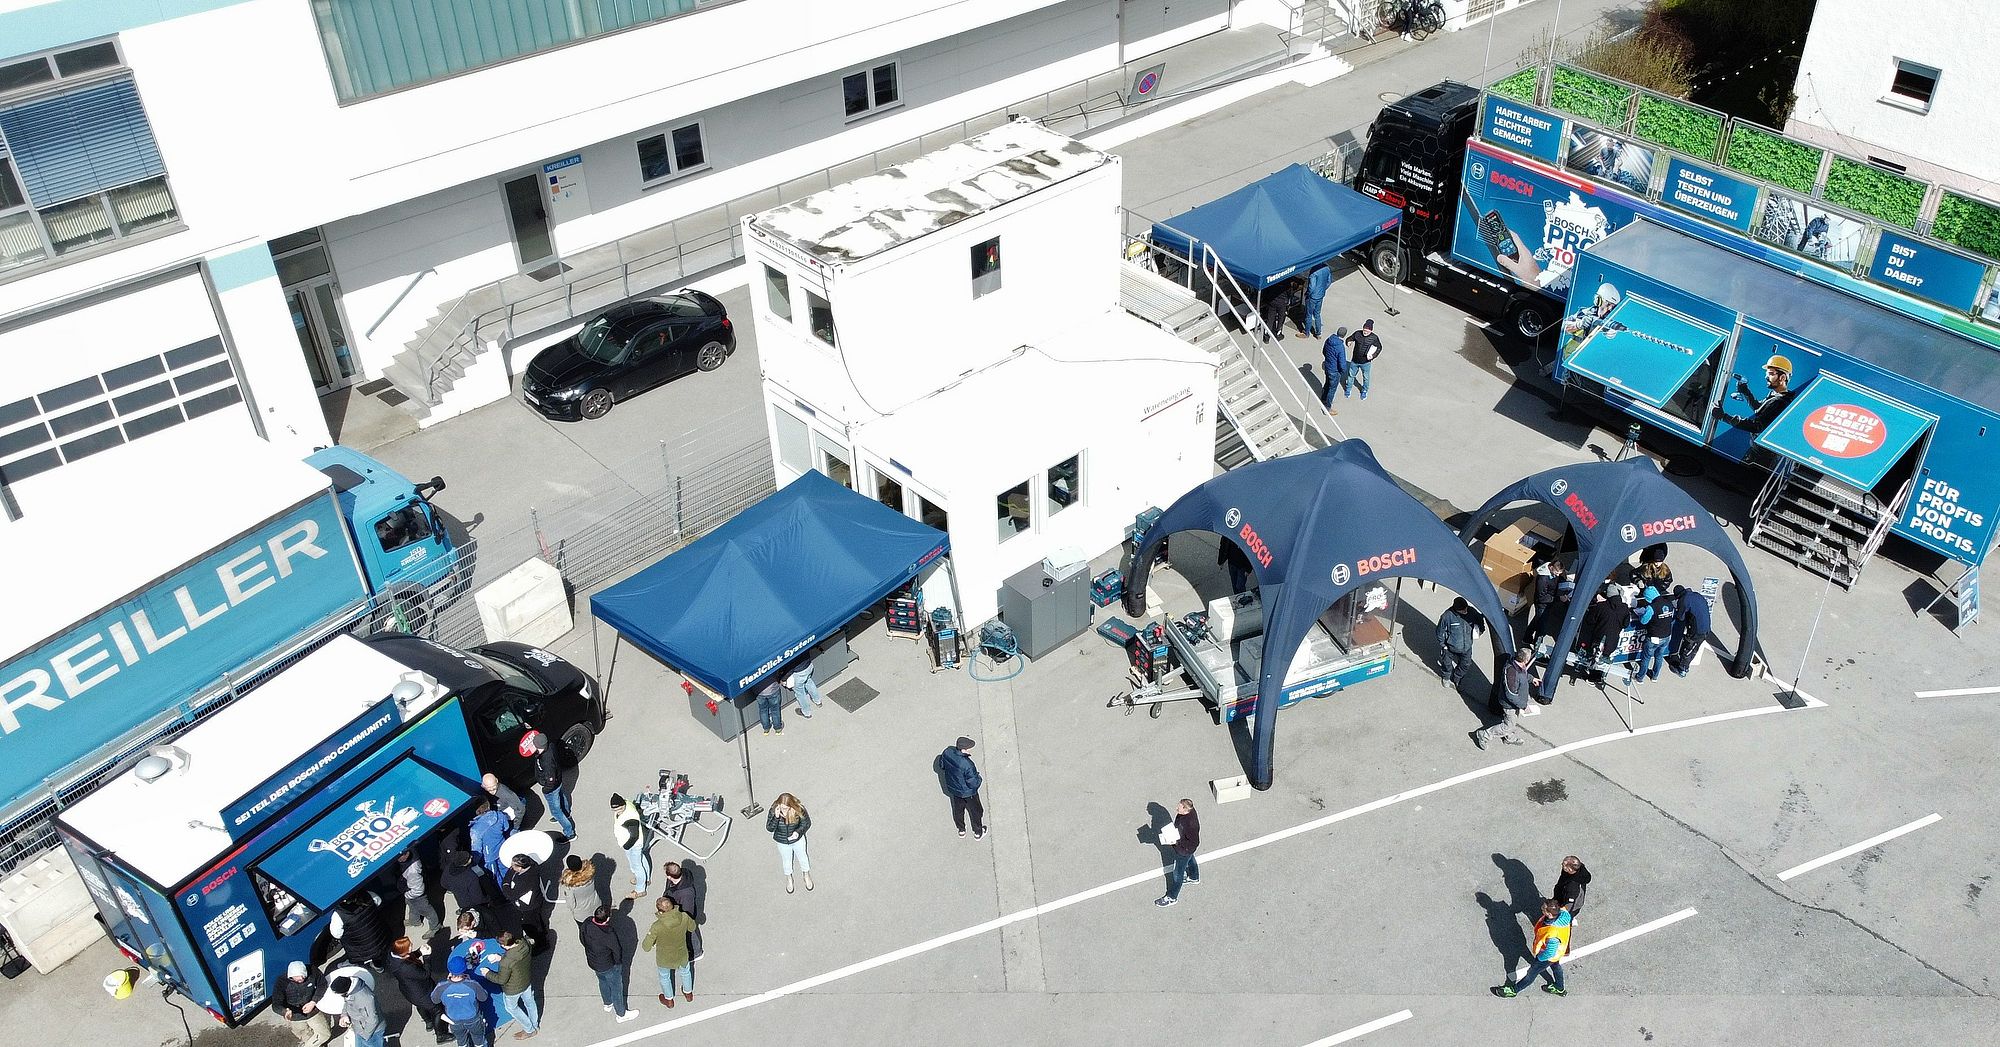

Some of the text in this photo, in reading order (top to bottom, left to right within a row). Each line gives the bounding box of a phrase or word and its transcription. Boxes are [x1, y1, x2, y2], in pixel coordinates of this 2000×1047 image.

[1494, 116, 1532, 136] LEICHTER
[1495, 105, 1552, 131] HARTE ARBEIT
[1492, 127, 1533, 148] GEMACHT.
[546, 156, 580, 171] KREILLER
[1490, 170, 1534, 197] BOSCH
[1679, 168, 1714, 187] SELBST
[1674, 190, 1738, 221] ÜBERZEUGEN!
[1677, 180, 1732, 206] TESTEN UND
[1554, 216, 1589, 237] BOSCH
[1553, 246, 1574, 265] TO
[1887, 255, 1905, 268] DU
[1891, 243, 1917, 259] BIST
[1884, 267, 1924, 287] DABEI?
[1143, 386, 1191, 414] Wareneingang
[1822, 413, 1874, 433] DABEI?
[1826, 405, 1879, 427] BIST DU
[1923, 477, 1960, 503] FÜR
[1564, 492, 1599, 530] BOSCH
[1915, 503, 1952, 529] VON
[1918, 491, 1983, 527] PROFIS
[1641, 515, 1696, 537] BOSCH
[1909, 516, 1976, 555] PROFIS.
[1238, 523, 1274, 569] BOSCH
[1356, 547, 1416, 576] BOSCH
[0, 519, 328, 738] REILLER
[739, 634, 816, 689] FlexiClick System
[234, 713, 392, 826] SEI TEIL DER BOSCH PRO COMMUNITY!
[332, 818, 369, 847] BOSCH
[335, 817, 392, 859] PRO
[358, 824, 407, 857] TOUR
[201, 866, 238, 896] BOSCH
